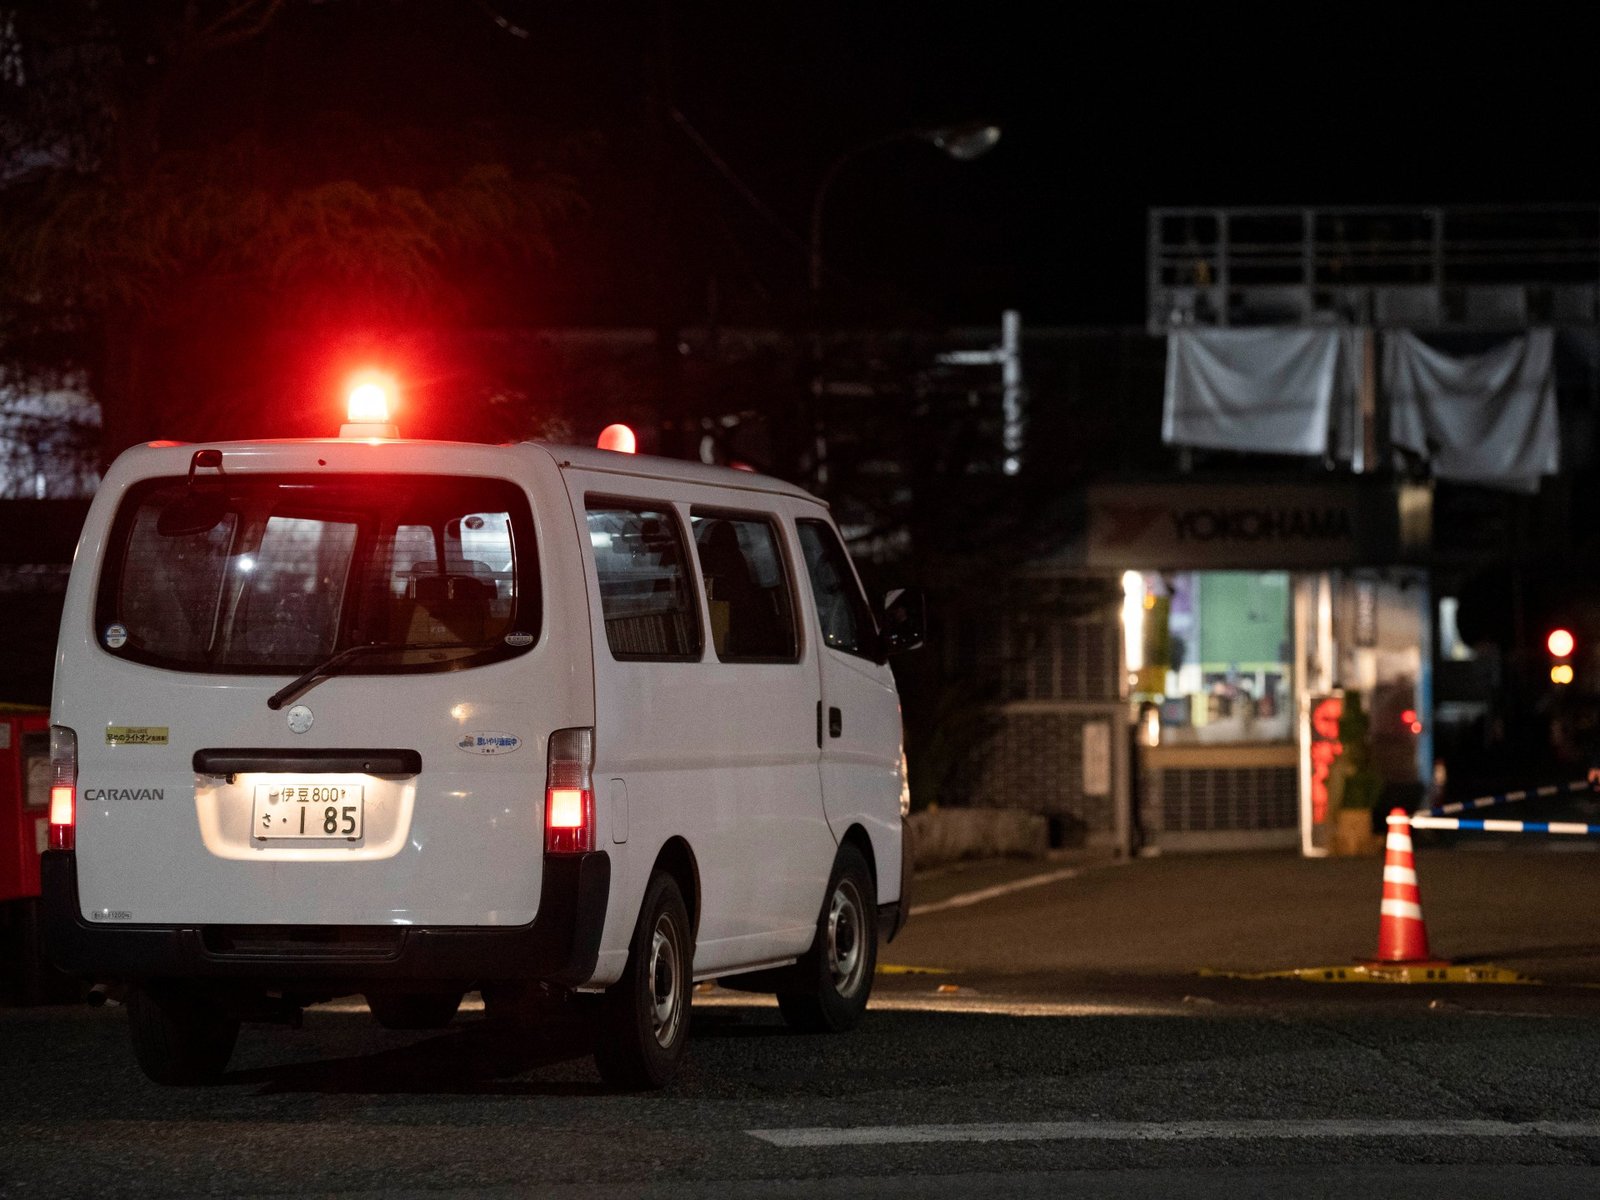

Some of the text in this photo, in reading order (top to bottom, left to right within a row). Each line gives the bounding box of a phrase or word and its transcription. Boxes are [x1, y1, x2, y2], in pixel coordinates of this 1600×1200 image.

[1172, 509, 1351, 541] YOKOHAMA
[84, 789, 164, 801] CARAVAN
[261, 812, 272, 829] さ
